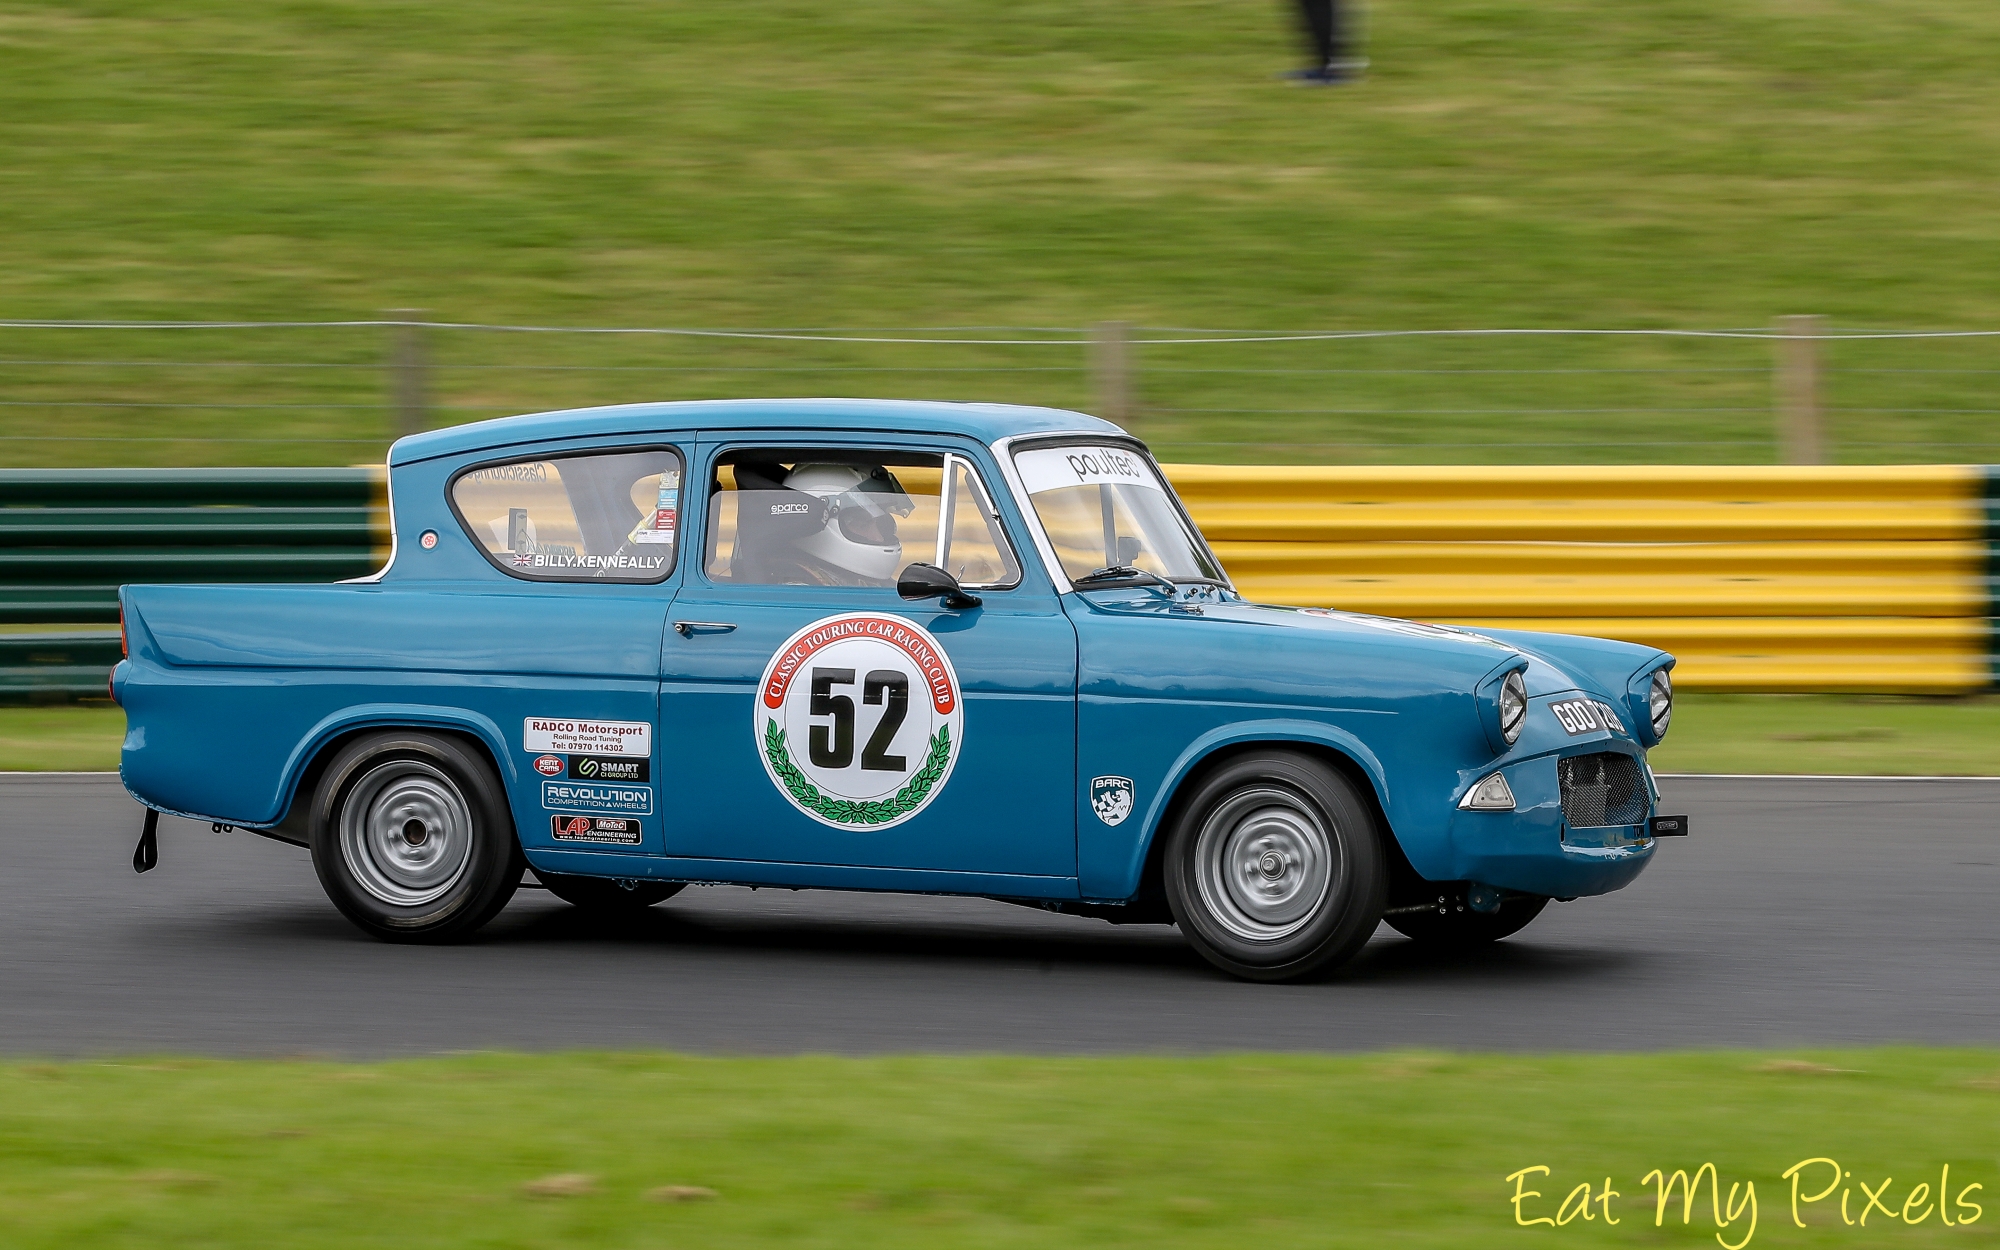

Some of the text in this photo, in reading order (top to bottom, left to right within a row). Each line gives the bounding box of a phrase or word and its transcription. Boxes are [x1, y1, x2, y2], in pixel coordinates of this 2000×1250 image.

[1066, 448, 1140, 482] poultec
[771, 503, 809, 515] sparco
[769, 621, 950, 704] CLASSIC TOURING CAR RACING CLUB
[808, 666, 909, 772] 52
[532, 721, 643, 737] RADCO Motorsport
[553, 733, 622, 744] Rolling Road Tuning
[552, 742, 623, 752] Tel: 07970 114302
[601, 762, 639, 773] SMART
[1095, 778, 1130, 790] BARC
[547, 786, 647, 802] REVOLUTION
[547, 797, 647, 810] COMPETITION WHEELS
[555, 816, 591, 835] LAP
[586, 830, 637, 839] ENGINEERING
